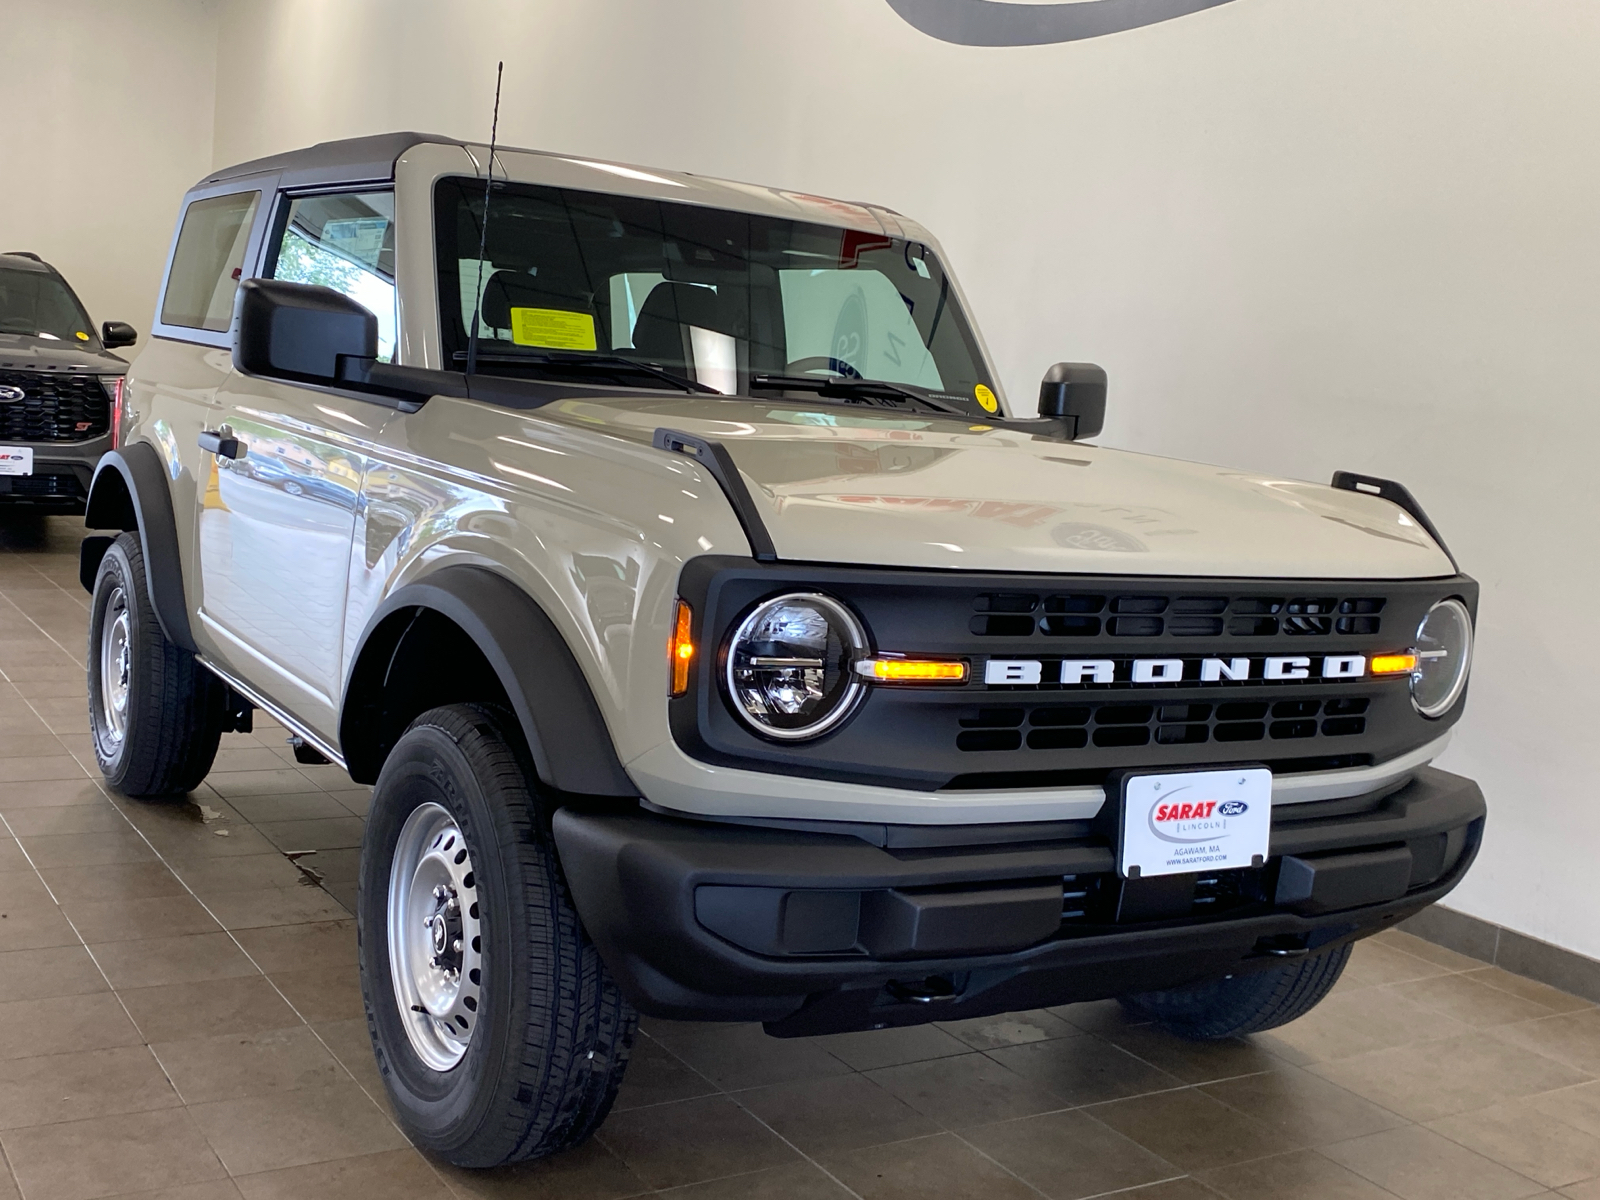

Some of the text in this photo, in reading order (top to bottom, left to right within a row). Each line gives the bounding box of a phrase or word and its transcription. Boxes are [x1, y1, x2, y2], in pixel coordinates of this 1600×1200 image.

[75, 422, 92, 431] ST
[984, 655, 1366, 685] BRONCO
[1155, 801, 1245, 822] SARAT Ford
[1182, 822, 1220, 831] LINCOLN
[1174, 845, 1220, 856] AGAWAM, MA
[1166, 855, 1227, 865] WWW.SARATFORD.COM
